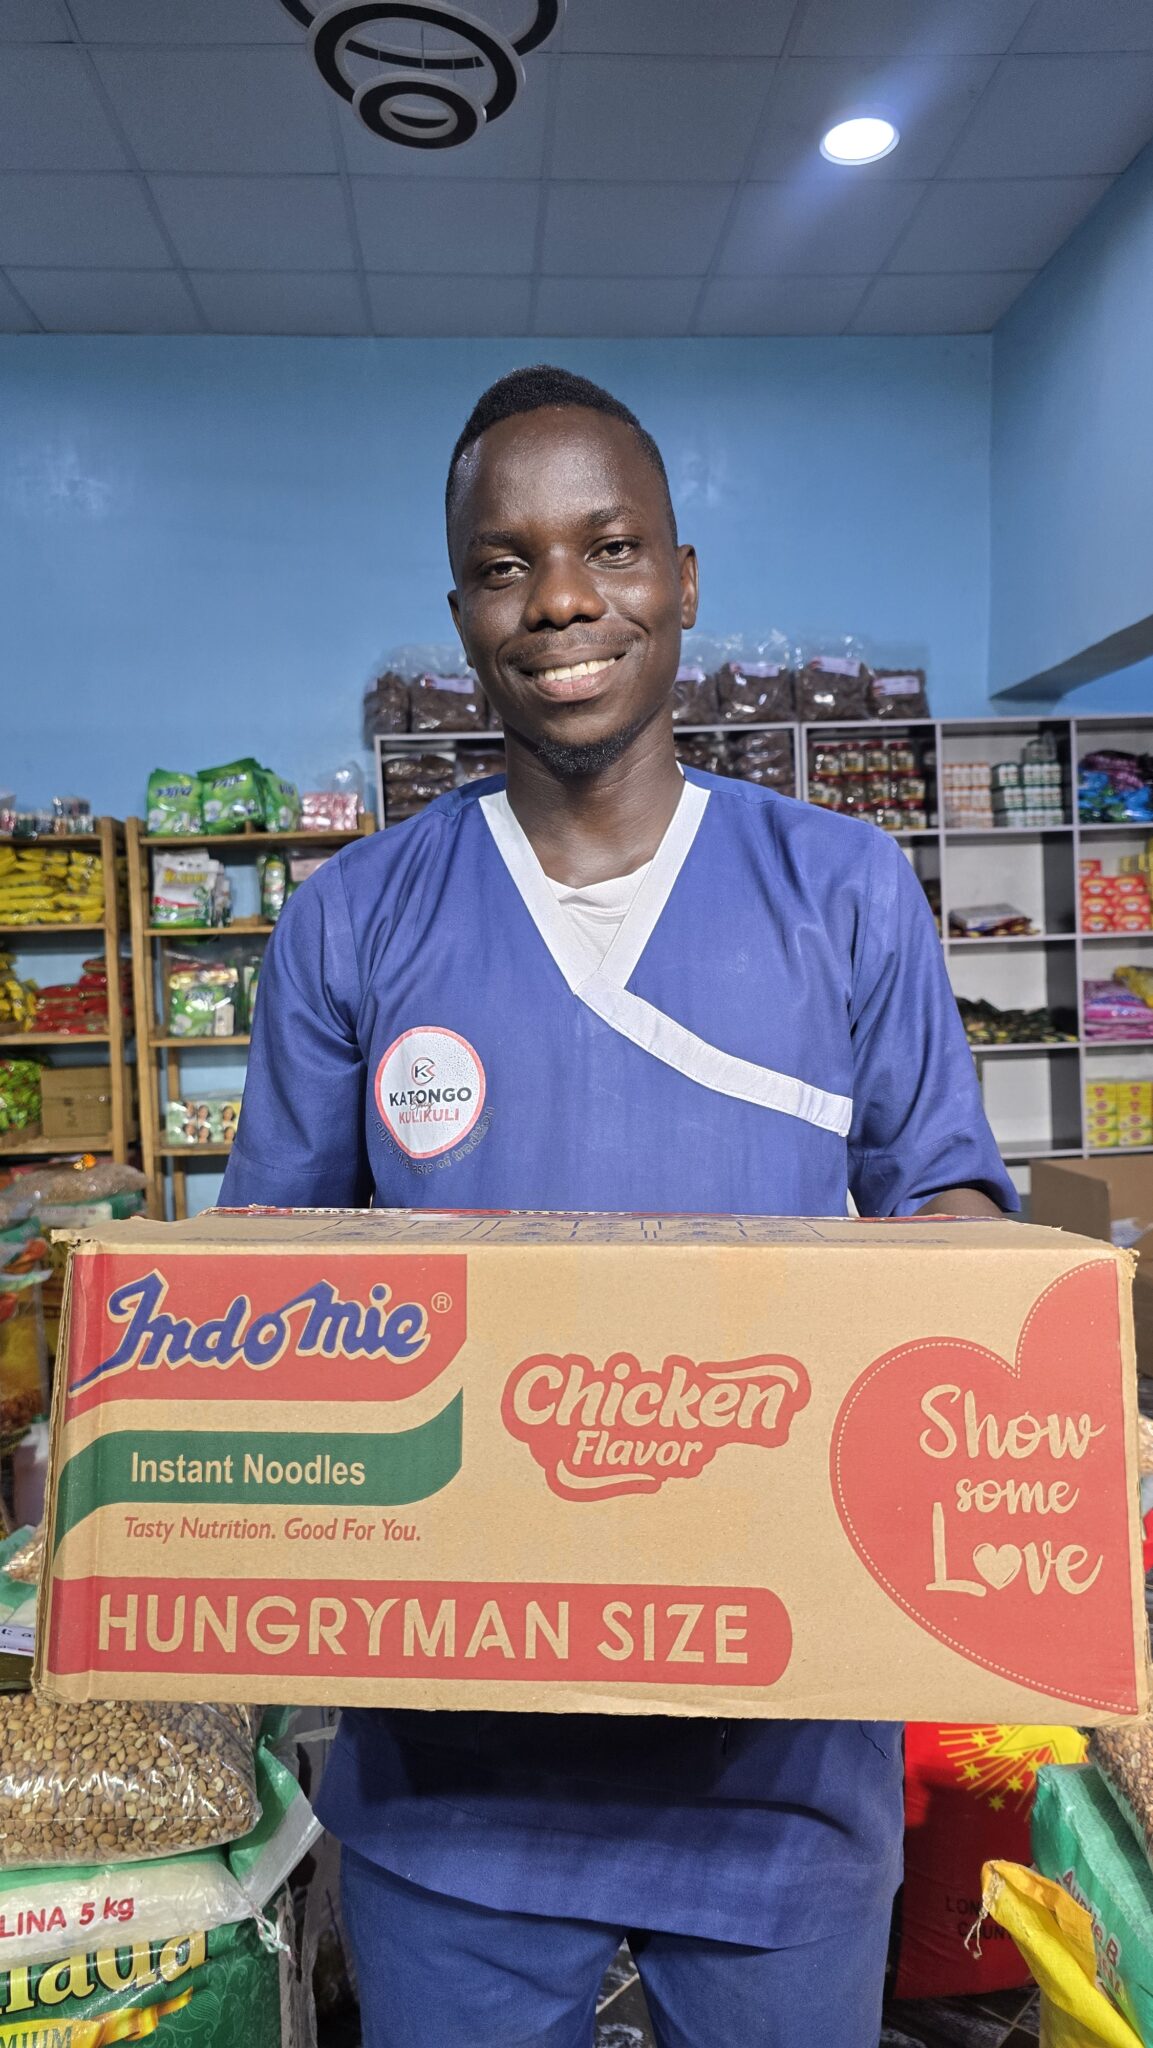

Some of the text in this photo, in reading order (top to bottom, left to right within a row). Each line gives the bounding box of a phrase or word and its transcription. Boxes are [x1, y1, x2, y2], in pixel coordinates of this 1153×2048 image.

[389, 1087, 472, 1106] KATONGO
[399, 1108, 460, 1124] KULIKULI
[513, 1363, 786, 1429] Chicken
[919, 1384, 1106, 1460] Show
[572, 1430, 703, 1467] Flavor
[131, 1451, 367, 1487] Instant Noodles
[955, 1478, 1080, 1515] some
[124, 1516, 421, 1545] Tasty Nutrition. Good For You.
[98, 1593, 748, 1664] HUNGRYMAN SIZE
[0, 1897, 135, 1938] LINA 5 kg
